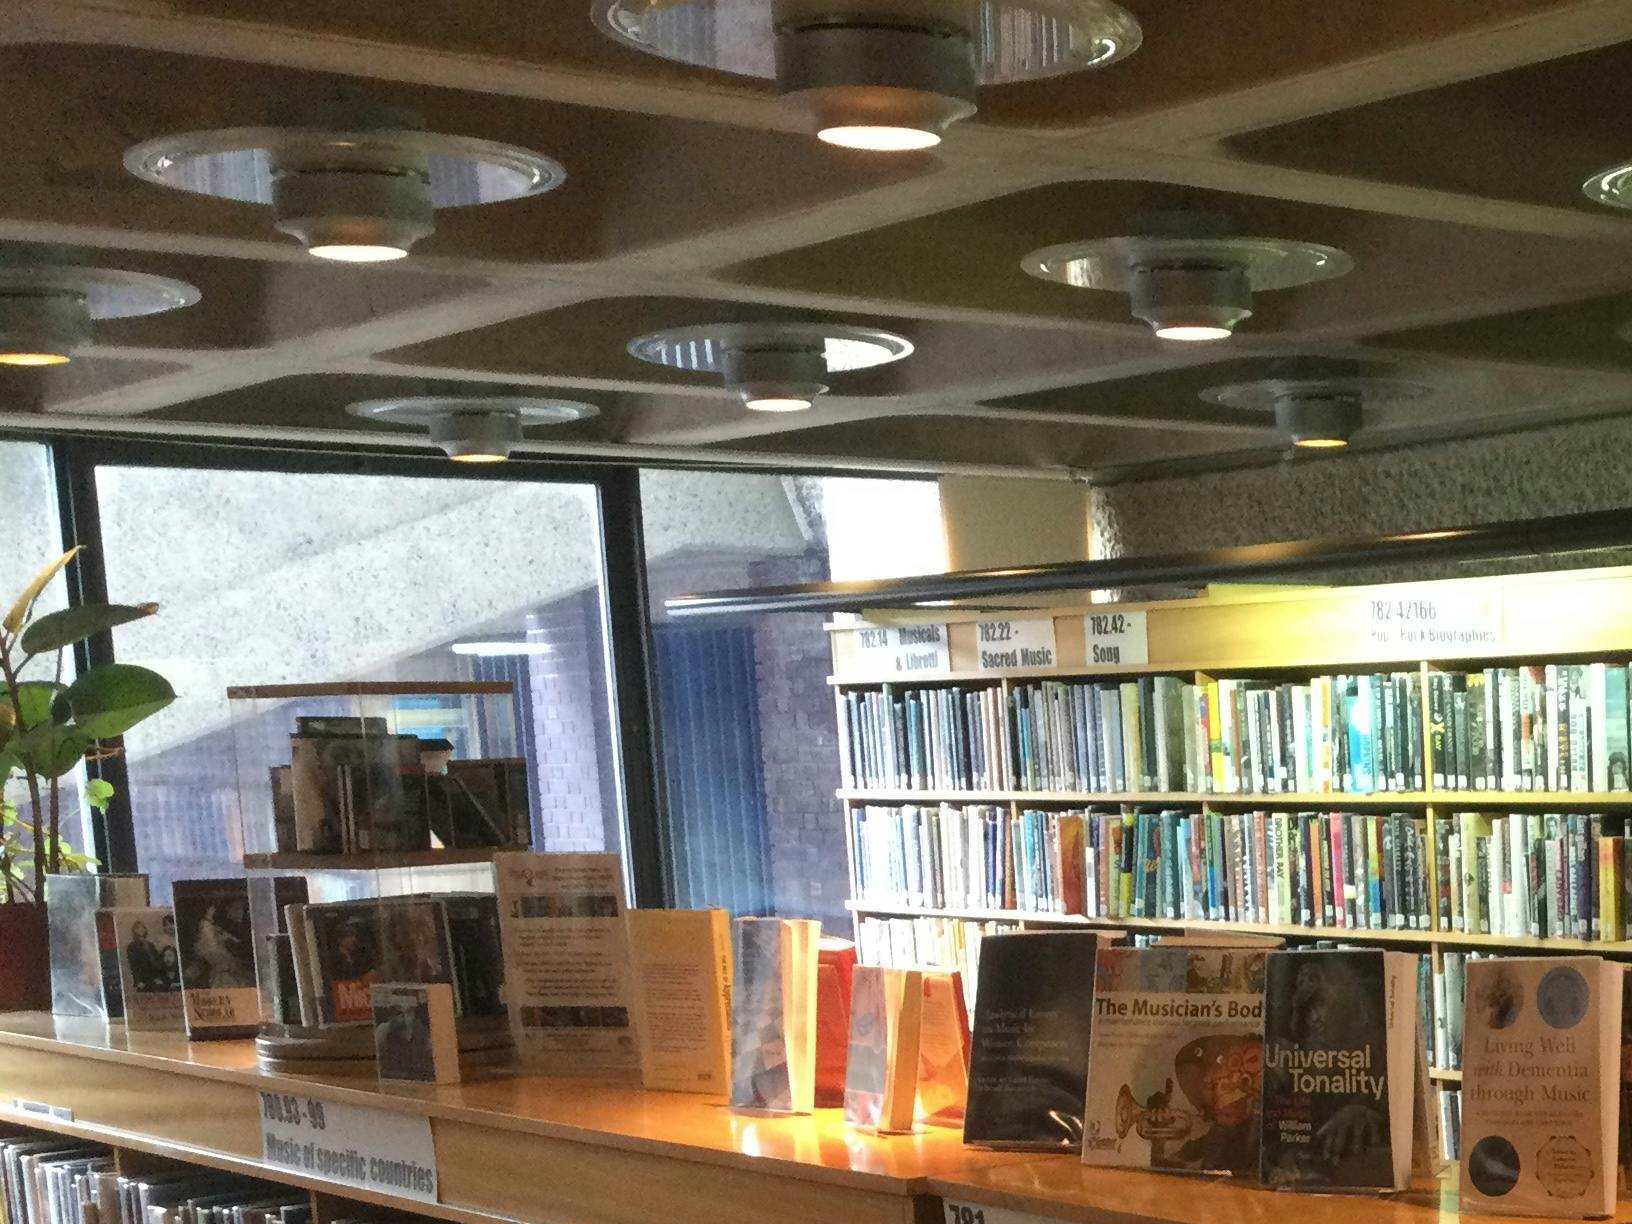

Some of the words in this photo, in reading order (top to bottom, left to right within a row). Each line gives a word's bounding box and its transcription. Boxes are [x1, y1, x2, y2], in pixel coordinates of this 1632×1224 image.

[899, 623, 940, 644] Musicals
[978, 622, 1012, 642] 782.22
[1090, 615, 1125, 635] 782.42
[906, 650, 939, 670] Libretti
[981, 648, 1018, 668] Sacred
[1021, 646, 1053, 666] Music
[1093, 643, 1120, 664] Song
[1275, 818, 1284, 860] BROTHER
[1276, 862, 1285, 880] RAY
[1096, 998, 1128, 1016] The
[1132, 999, 1223, 1018] Musician's
[1227, 1000, 1263, 1018] Bod
[1265, 1043, 1372, 1069] Universal
[1484, 1035, 1535, 1057] Living
[1540, 1034, 1577, 1053] Well
[1473, 1061, 1504, 1077] with
[1508, 1061, 1590, 1078] Dementia
[1288, 1067, 1386, 1101] Tonality
[1470, 1083, 1535, 1106] through
[1542, 1083, 1592, 1102] Music
[1278, 1119, 1312, 1132] William
[1280, 1131, 1312, 1144] Parker
[266, 1131, 300, 1163] Music
[303, 1143, 315, 1170] of
[317, 1148, 367, 1181] specific
[369, 1157, 434, 1193] countries
